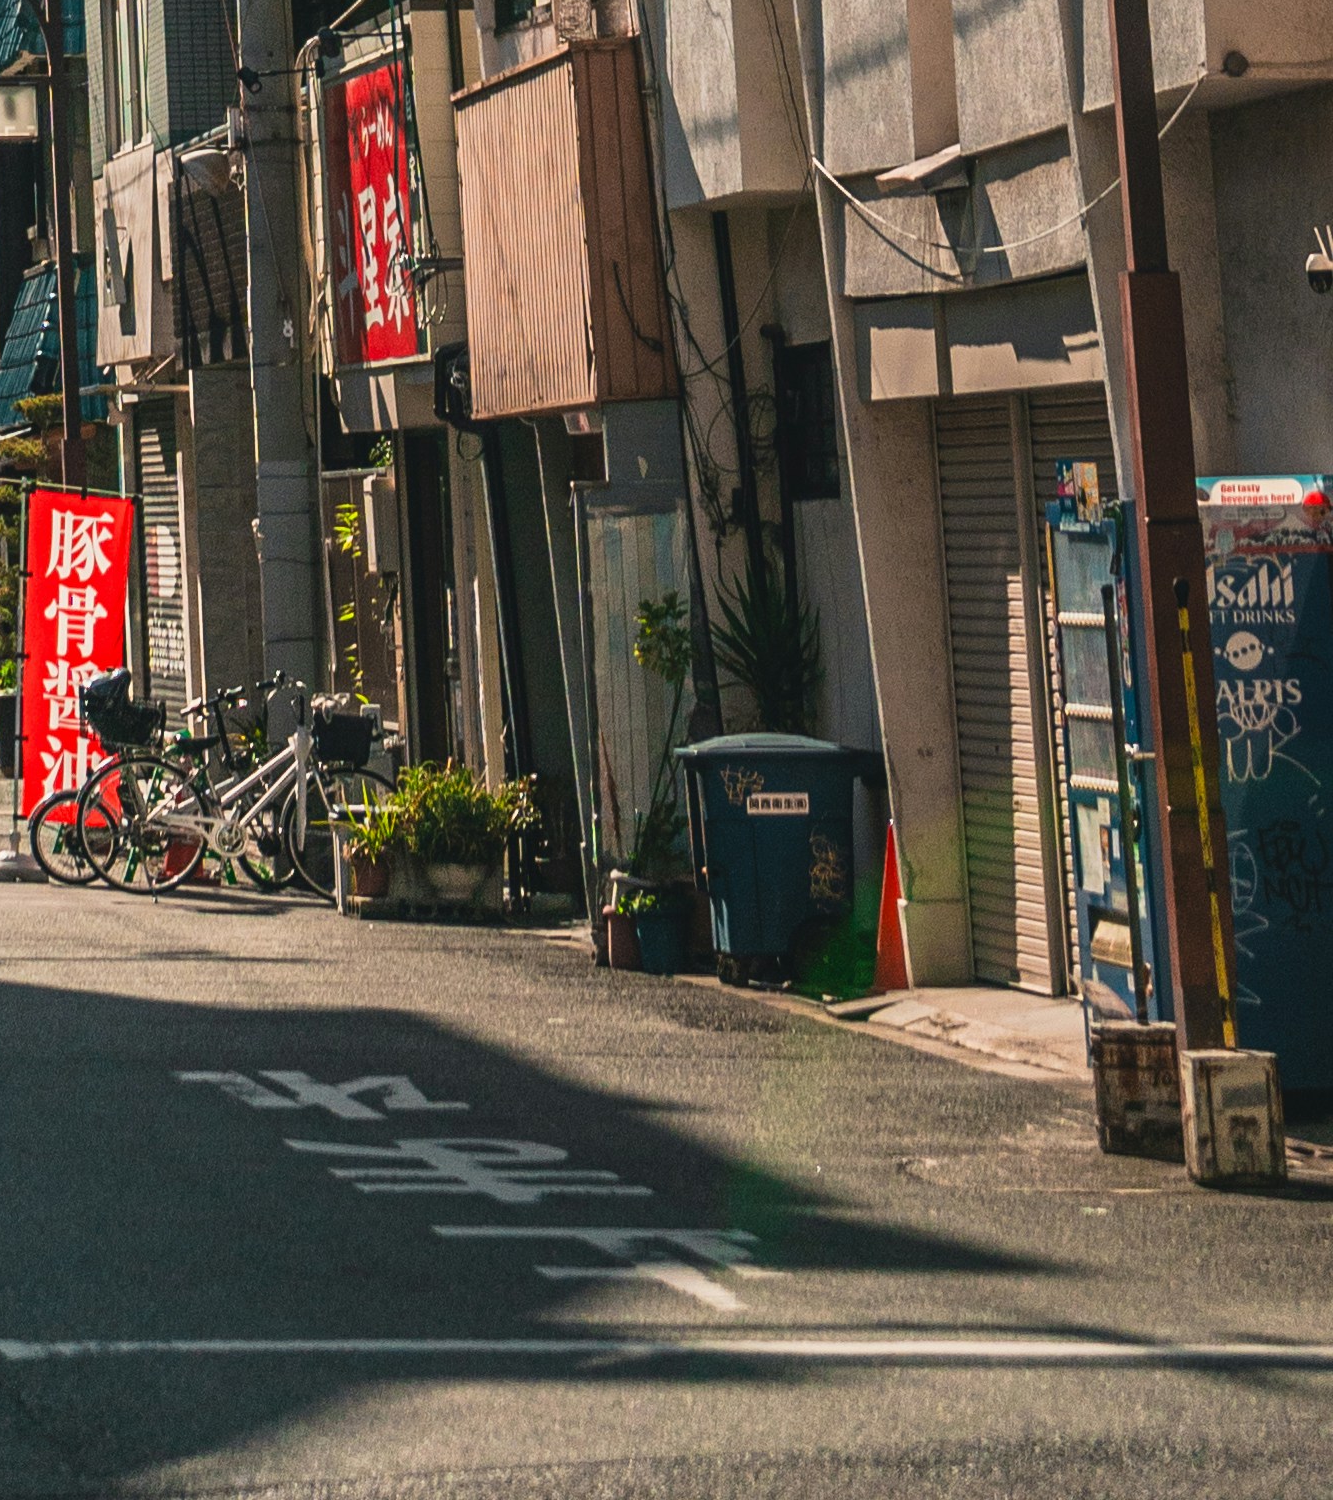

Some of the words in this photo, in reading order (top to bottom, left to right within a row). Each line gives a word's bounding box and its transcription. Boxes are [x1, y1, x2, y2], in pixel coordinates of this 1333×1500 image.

[1220, 484, 1236, 493] Get
[1237, 483, 1261, 494] tasty
[1220, 493, 1269, 505] beverages
[1270, 492, 1295, 503] here!
[1232, 609, 1296, 624] DRINKS
[40, 508, 115, 799] 豚骨醤油
